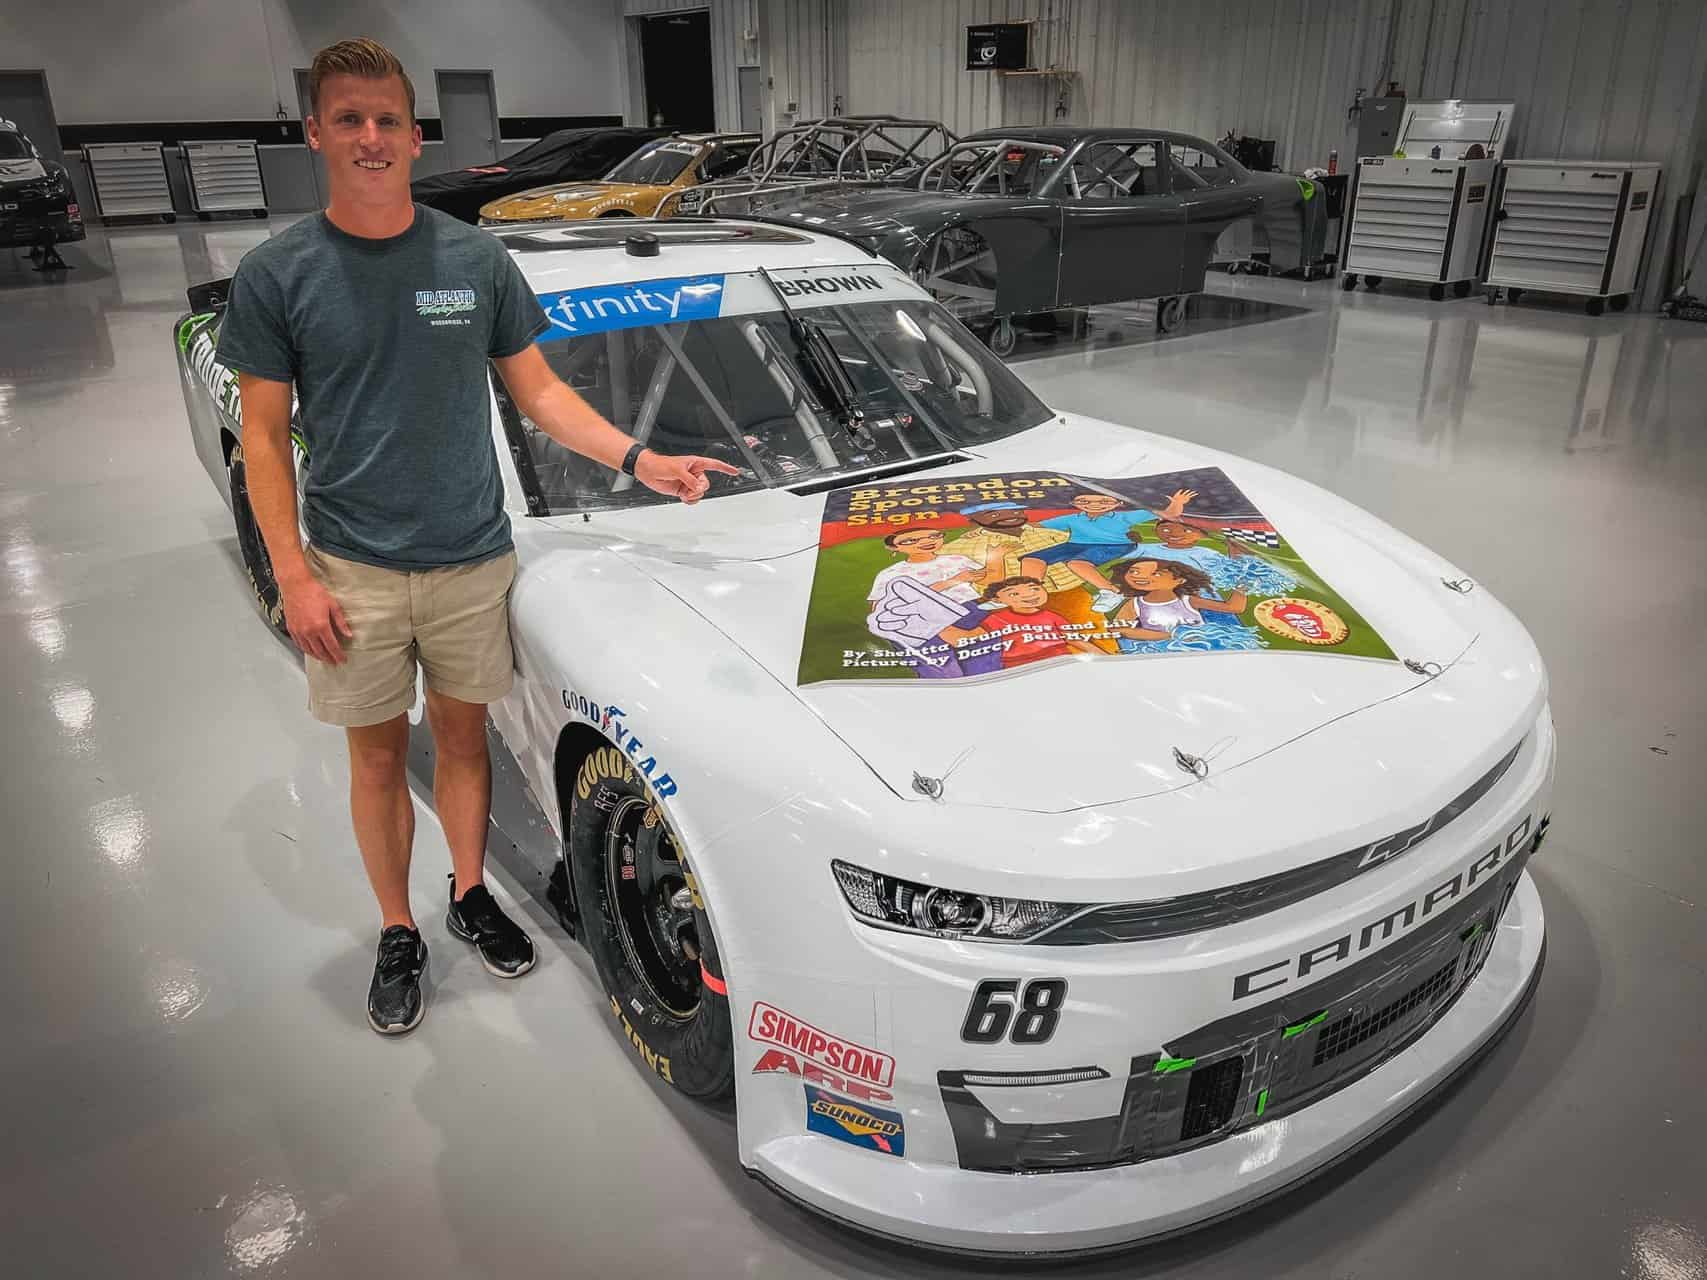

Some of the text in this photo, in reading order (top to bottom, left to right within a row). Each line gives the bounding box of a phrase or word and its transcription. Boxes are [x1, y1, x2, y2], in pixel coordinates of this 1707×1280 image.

[415, 289, 435, 306] MID
[774, 275, 883, 297] BROWN
[848, 488, 1046, 512] Spots His
[850, 477, 1072, 501] Brandon
[847, 510, 940, 527] Sign
[842, 650, 866, 660] By
[957, 622, 1055, 648] Brundidge
[1060, 620, 1096, 631] and
[1103, 617, 1139, 630] Lily
[842, 630, 1122, 668] Pictures by Darcy Bell-Myers
[1232, 813, 1532, 1001] CAMARO
[960, 977, 1069, 1045] 68
[757, 1009, 884, 1085] SIMPSON
[752, 1049, 895, 1102] ARP
[815, 1101, 898, 1134] SUNOCO
